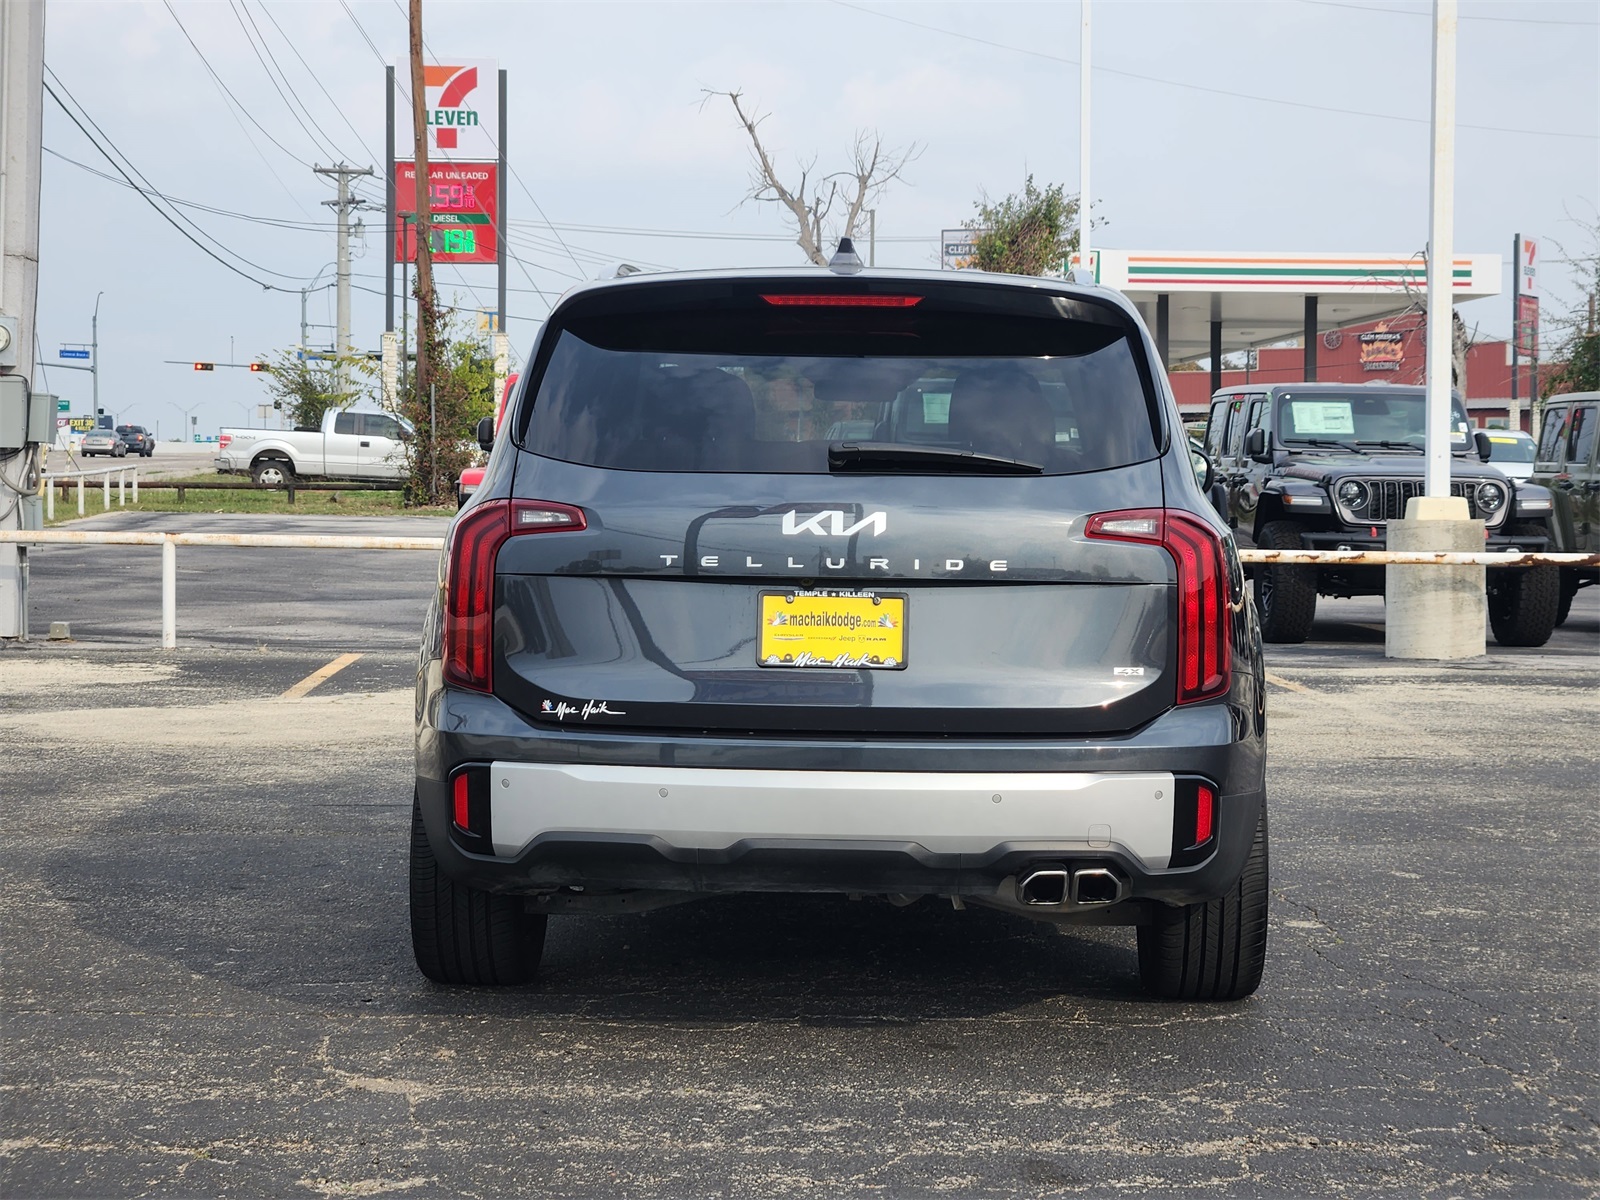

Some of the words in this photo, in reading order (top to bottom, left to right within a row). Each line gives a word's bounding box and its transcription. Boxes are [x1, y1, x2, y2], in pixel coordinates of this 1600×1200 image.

[426, 110, 479, 126] LEVEn
[405, 171, 443, 179] REAR
[445, 171, 489, 180] UNLEADED
[433, 214, 460, 223] DIESEL
[781, 509, 887, 537] KIA
[659, 554, 1008, 572] TELLURIDE
[789, 611, 877, 630] machaikdodge.com
[838, 635, 856, 643] Jeep
[793, 651, 831, 667] Mac
[831, 652, 875, 668] Haik
[553, 701, 579, 720] Mac
[581, 699, 620, 720] Haik
